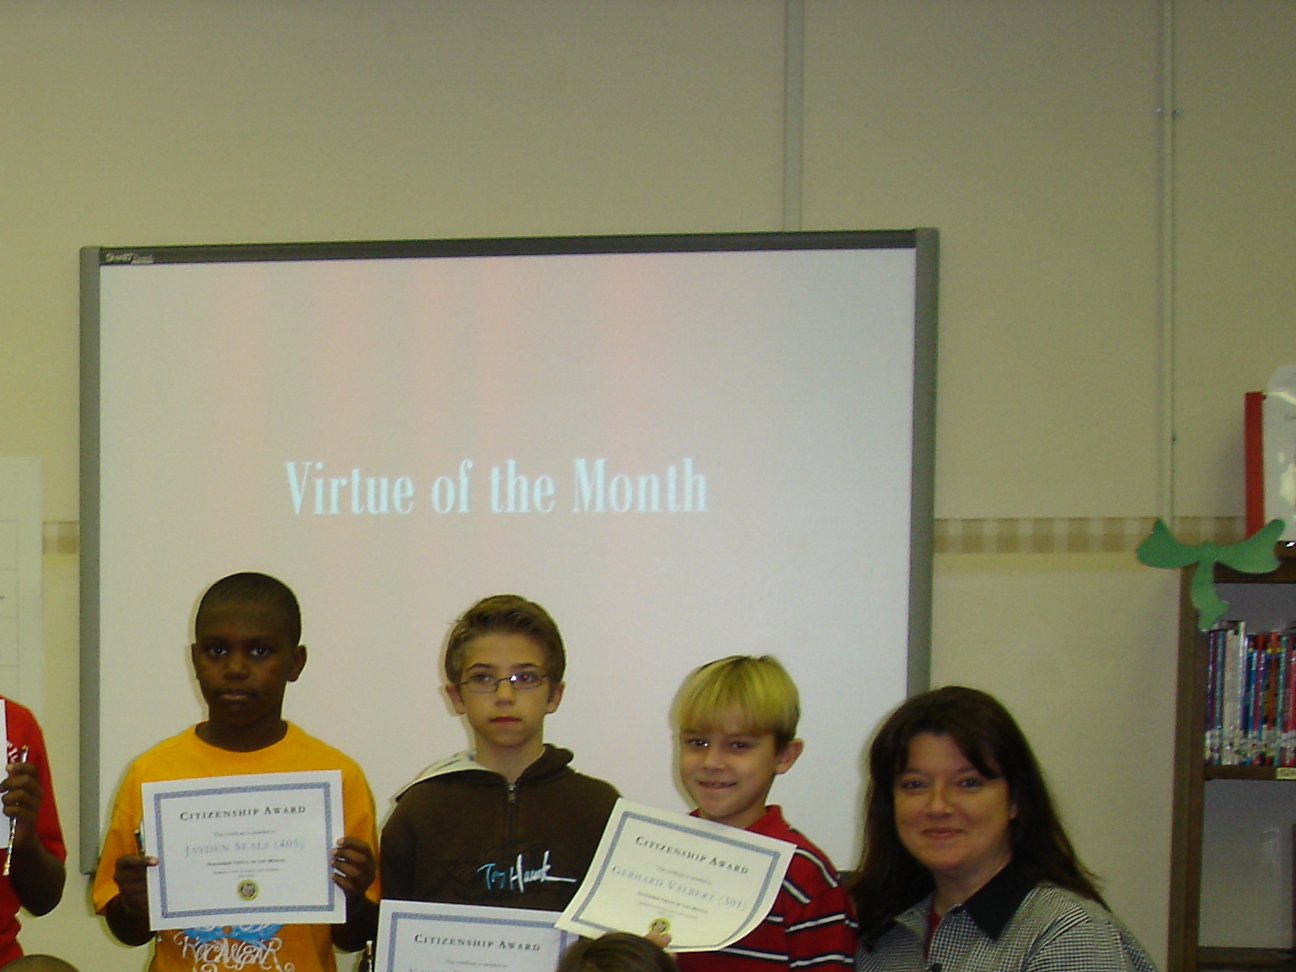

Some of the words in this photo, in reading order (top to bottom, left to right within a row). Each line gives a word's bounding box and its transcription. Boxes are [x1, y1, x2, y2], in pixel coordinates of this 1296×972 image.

[283, 460, 415, 516] Virtue
[431, 459, 474, 514] of
[488, 458, 555, 514] the
[571, 457, 710, 514] Month
[180, 808, 260, 821] CITIZENSHIP
[263, 805, 306, 816] AWARD
[635, 836, 707, 862] CITIZENSHIP
[708, 855, 750, 875] AWARD
[414, 934, 494, 948] CITIZENSHIP
[497, 940, 541, 952] AWARD
